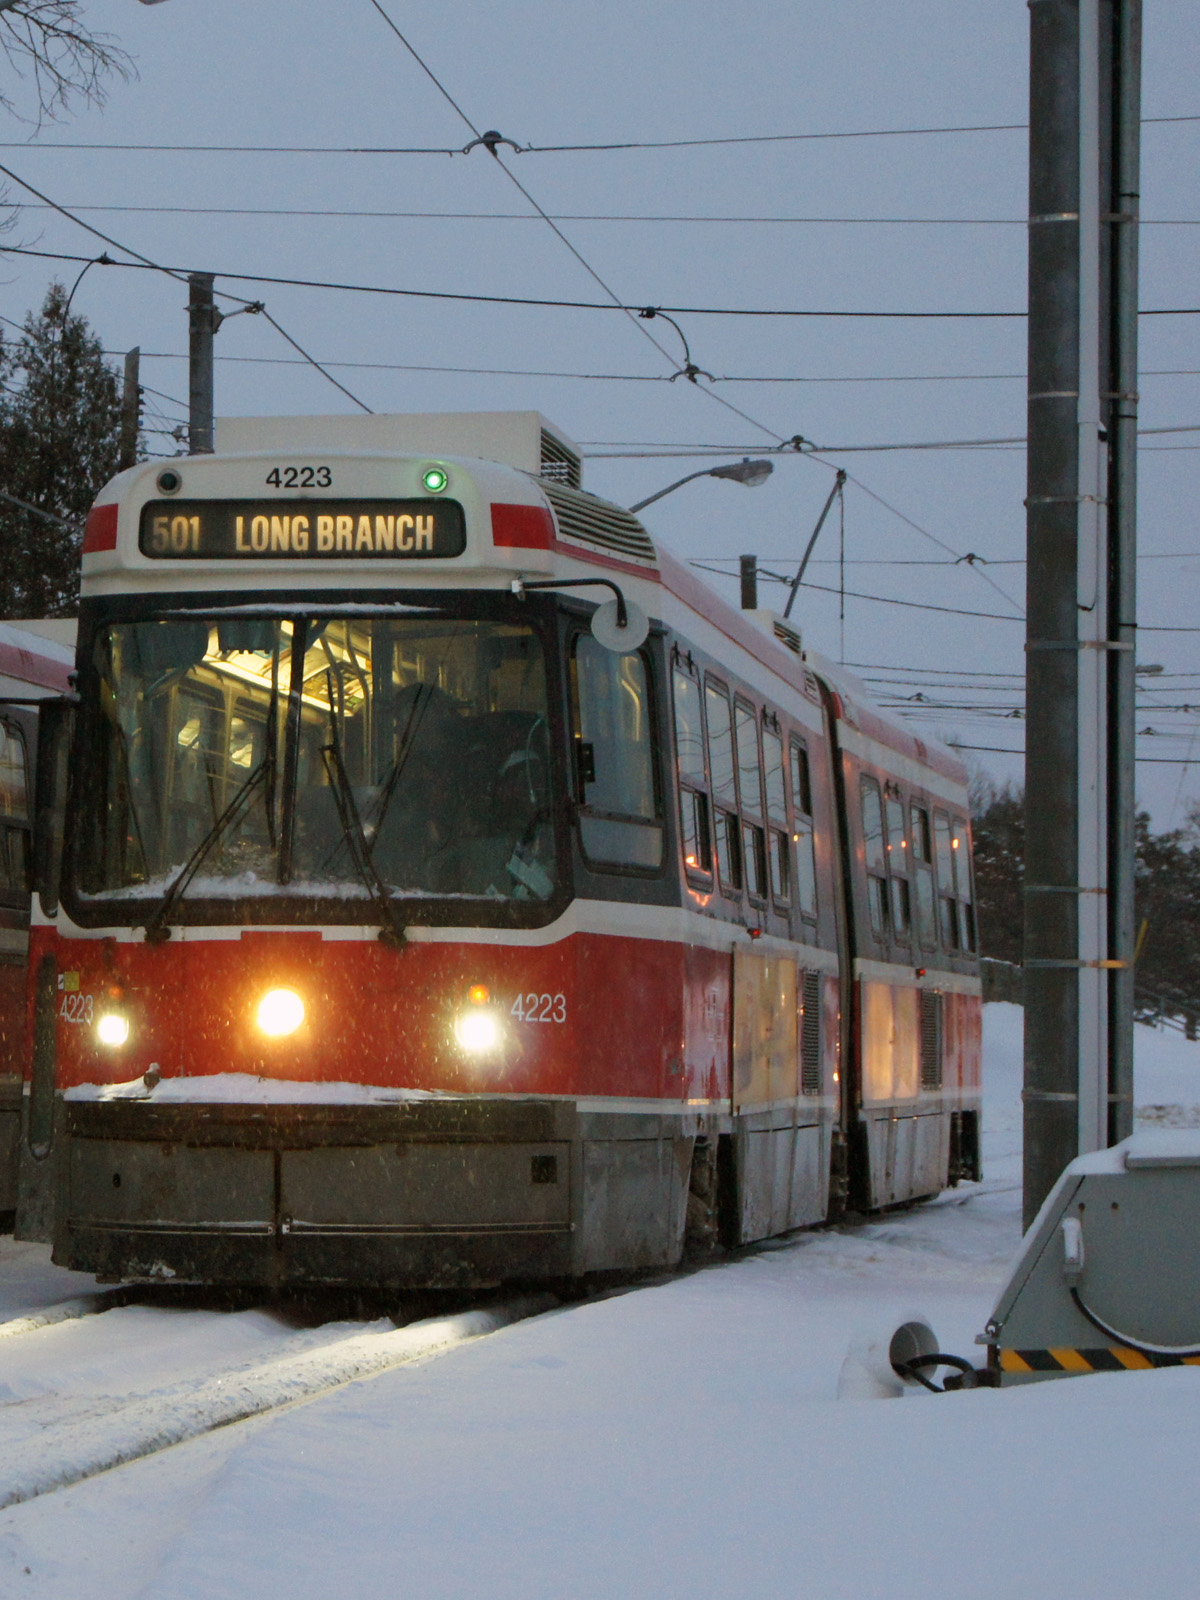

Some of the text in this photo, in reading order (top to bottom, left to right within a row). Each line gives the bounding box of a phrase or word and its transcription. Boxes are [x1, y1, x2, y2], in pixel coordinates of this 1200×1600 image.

[266, 466, 333, 489] 4223
[152, 514, 434, 552] 501 LONG BRANCH
[60, 994, 94, 1023] 4223
[510, 993, 566, 1023] 4223
